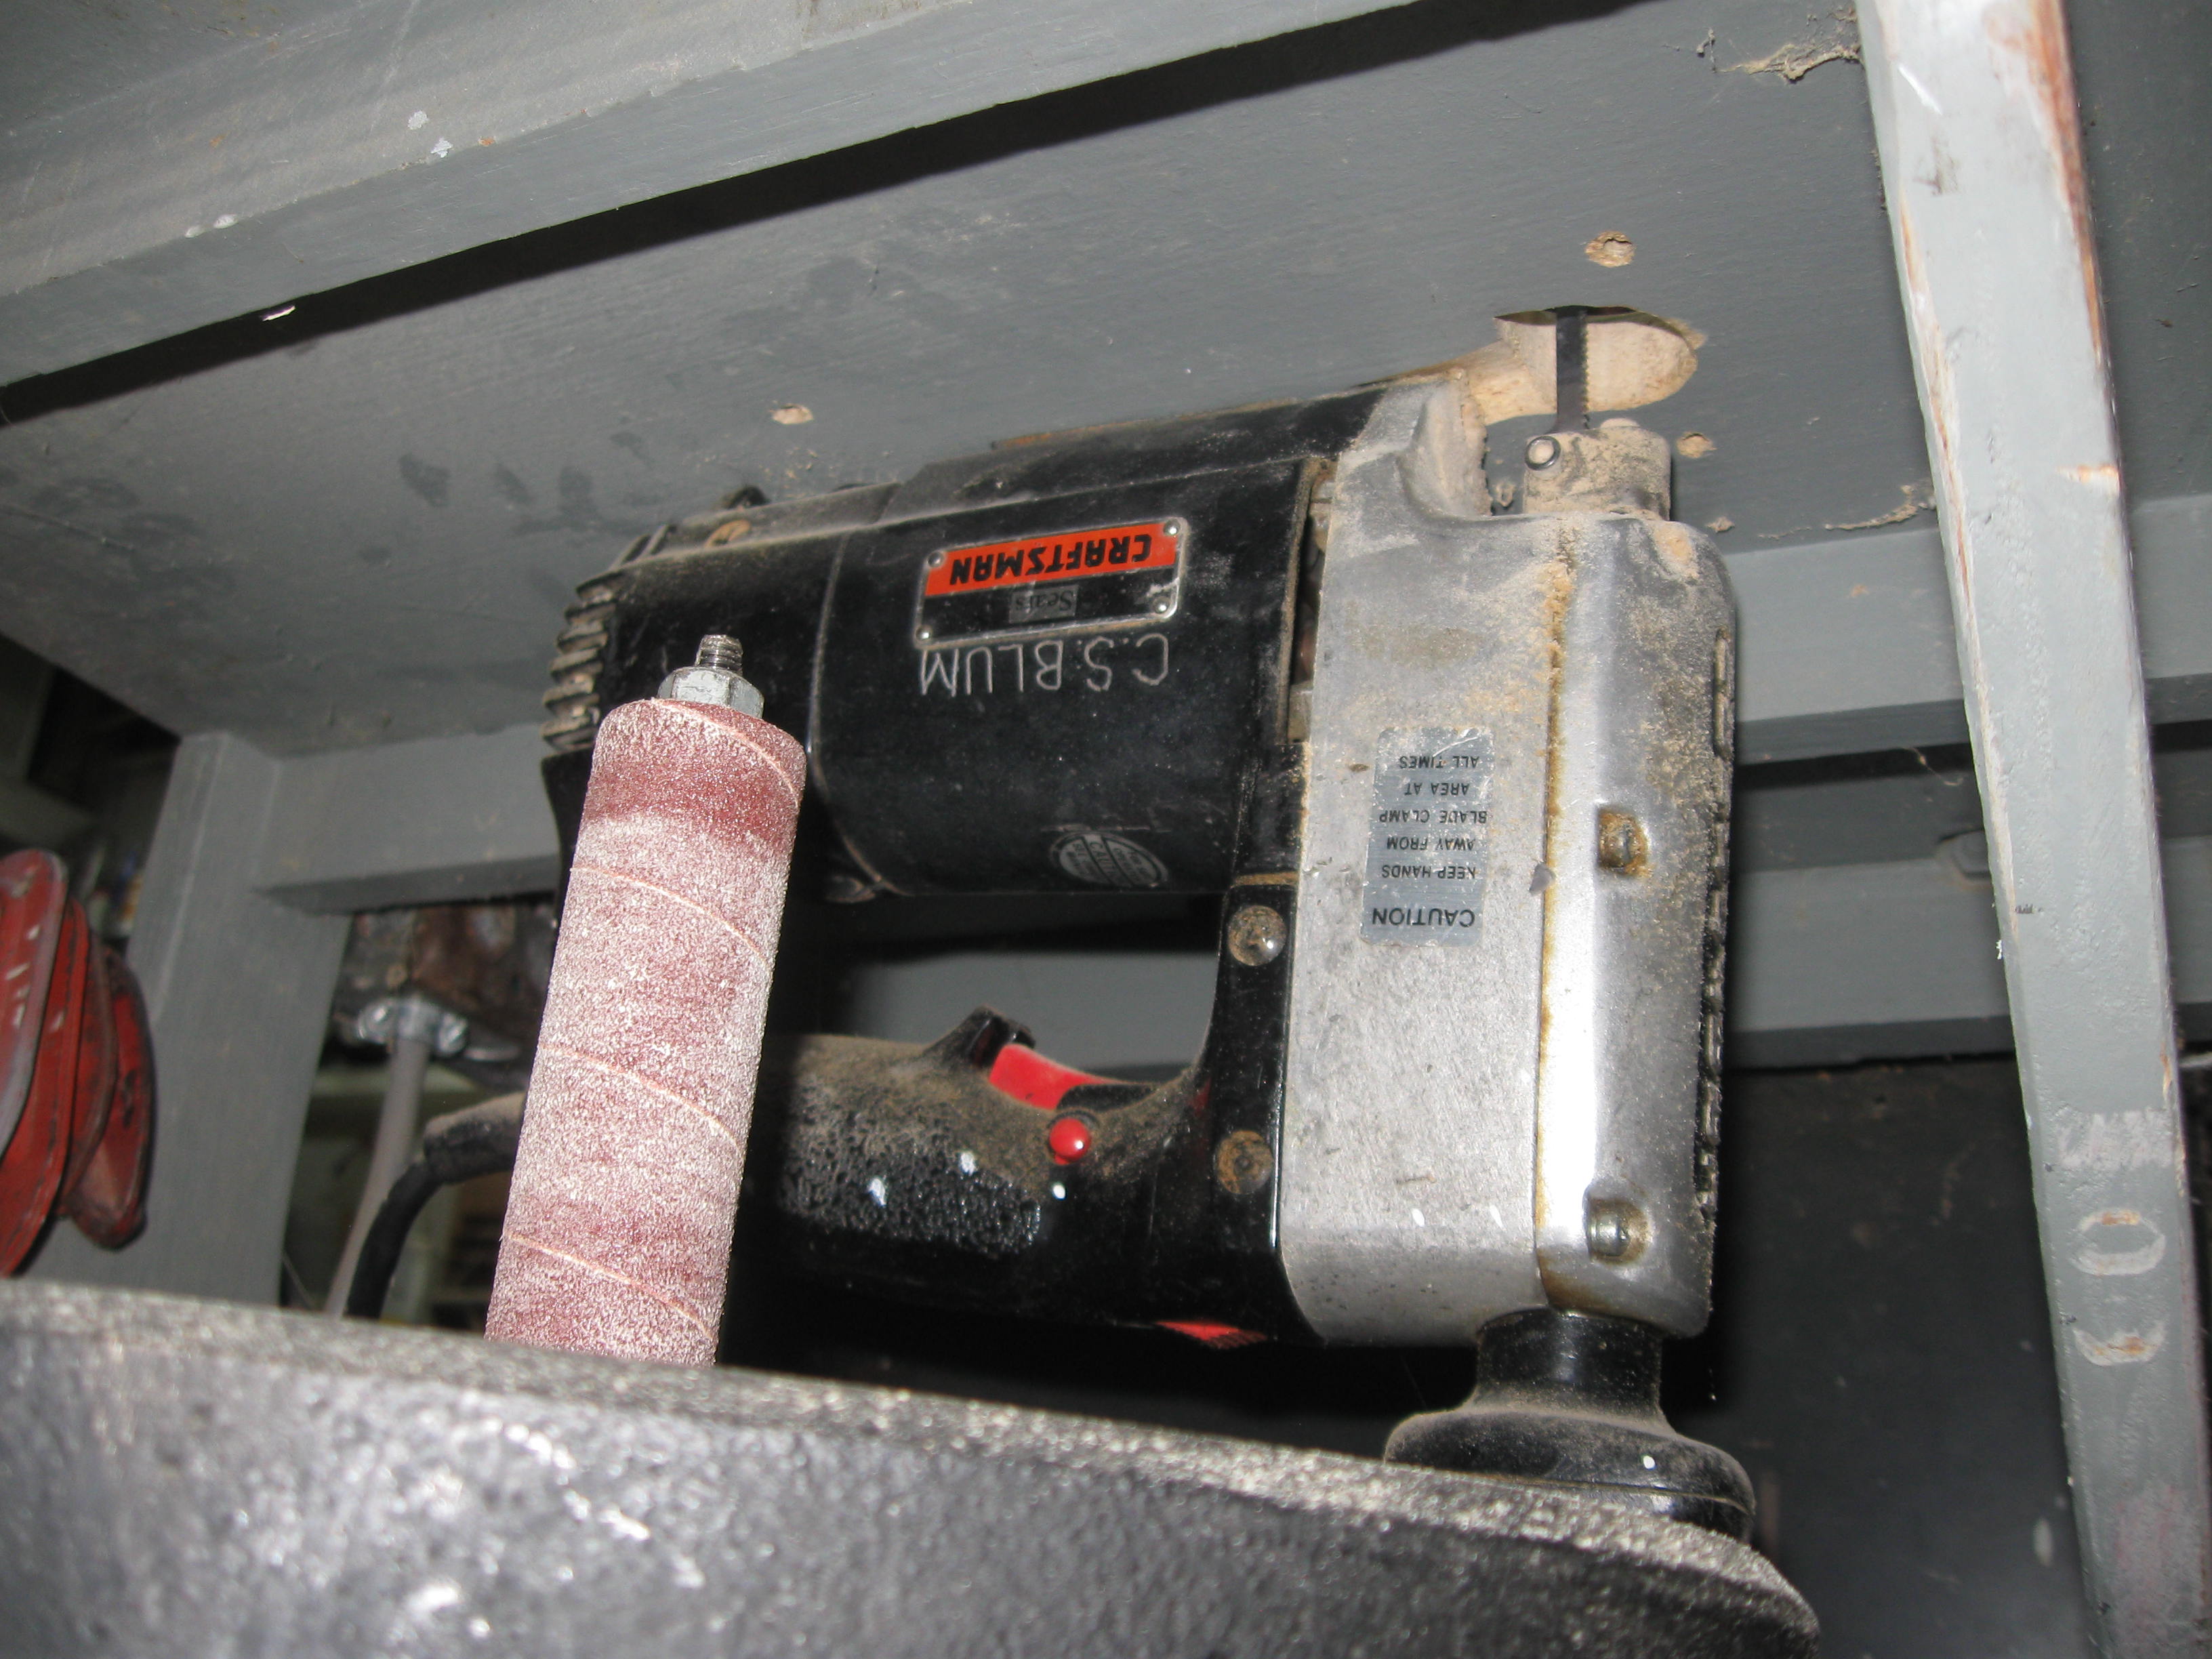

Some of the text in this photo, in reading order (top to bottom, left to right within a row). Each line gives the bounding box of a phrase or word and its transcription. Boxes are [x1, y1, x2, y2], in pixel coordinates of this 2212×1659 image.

[949, 534, 1152, 586] CRAFTSMAN
[1016, 590, 1074, 611] Sears
[920, 640, 1063, 697] BLUM
[1399, 755, 1480, 769] ALL TIMES
[1404, 782, 1470, 796] AREA AT
[1379, 810, 1430, 823] CLAMP
[1387, 836, 1476, 851] AWAY FROM
[1382, 865, 1476, 880] KEEP HANDS
[1372, 907, 1476, 928] CAUTION
